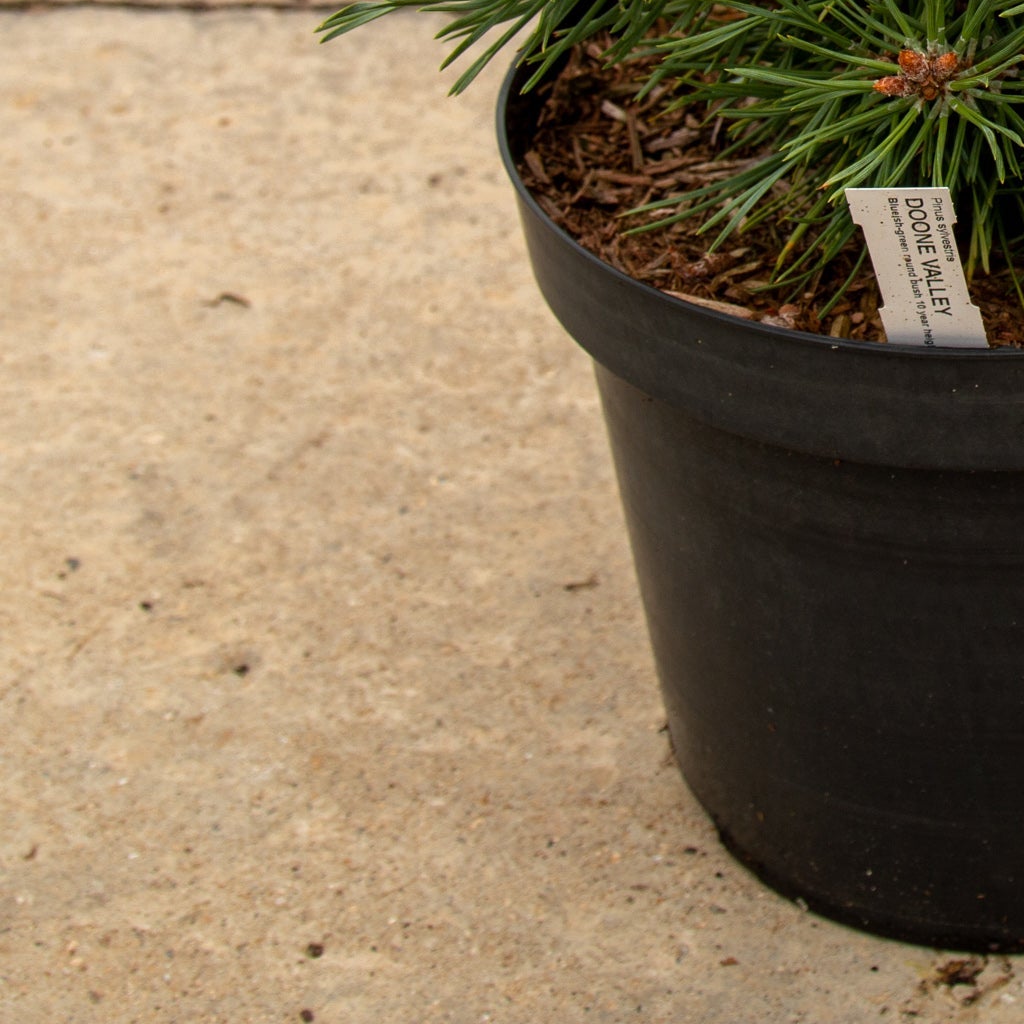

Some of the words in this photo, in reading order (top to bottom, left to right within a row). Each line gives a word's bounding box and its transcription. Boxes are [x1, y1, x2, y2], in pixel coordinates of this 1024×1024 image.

[931, 197, 945, 222] Pinus
[936, 223, 954, 262] sylvestris
[904, 254, 918, 278] round
[905, 198, 937, 255] DOONE
[921, 258, 952, 317] VALLEY
[910, 279, 922, 299] bush
[916, 300, 926, 310] 10
[916, 310, 930, 327] year
[924, 328, 936, 348] heig
